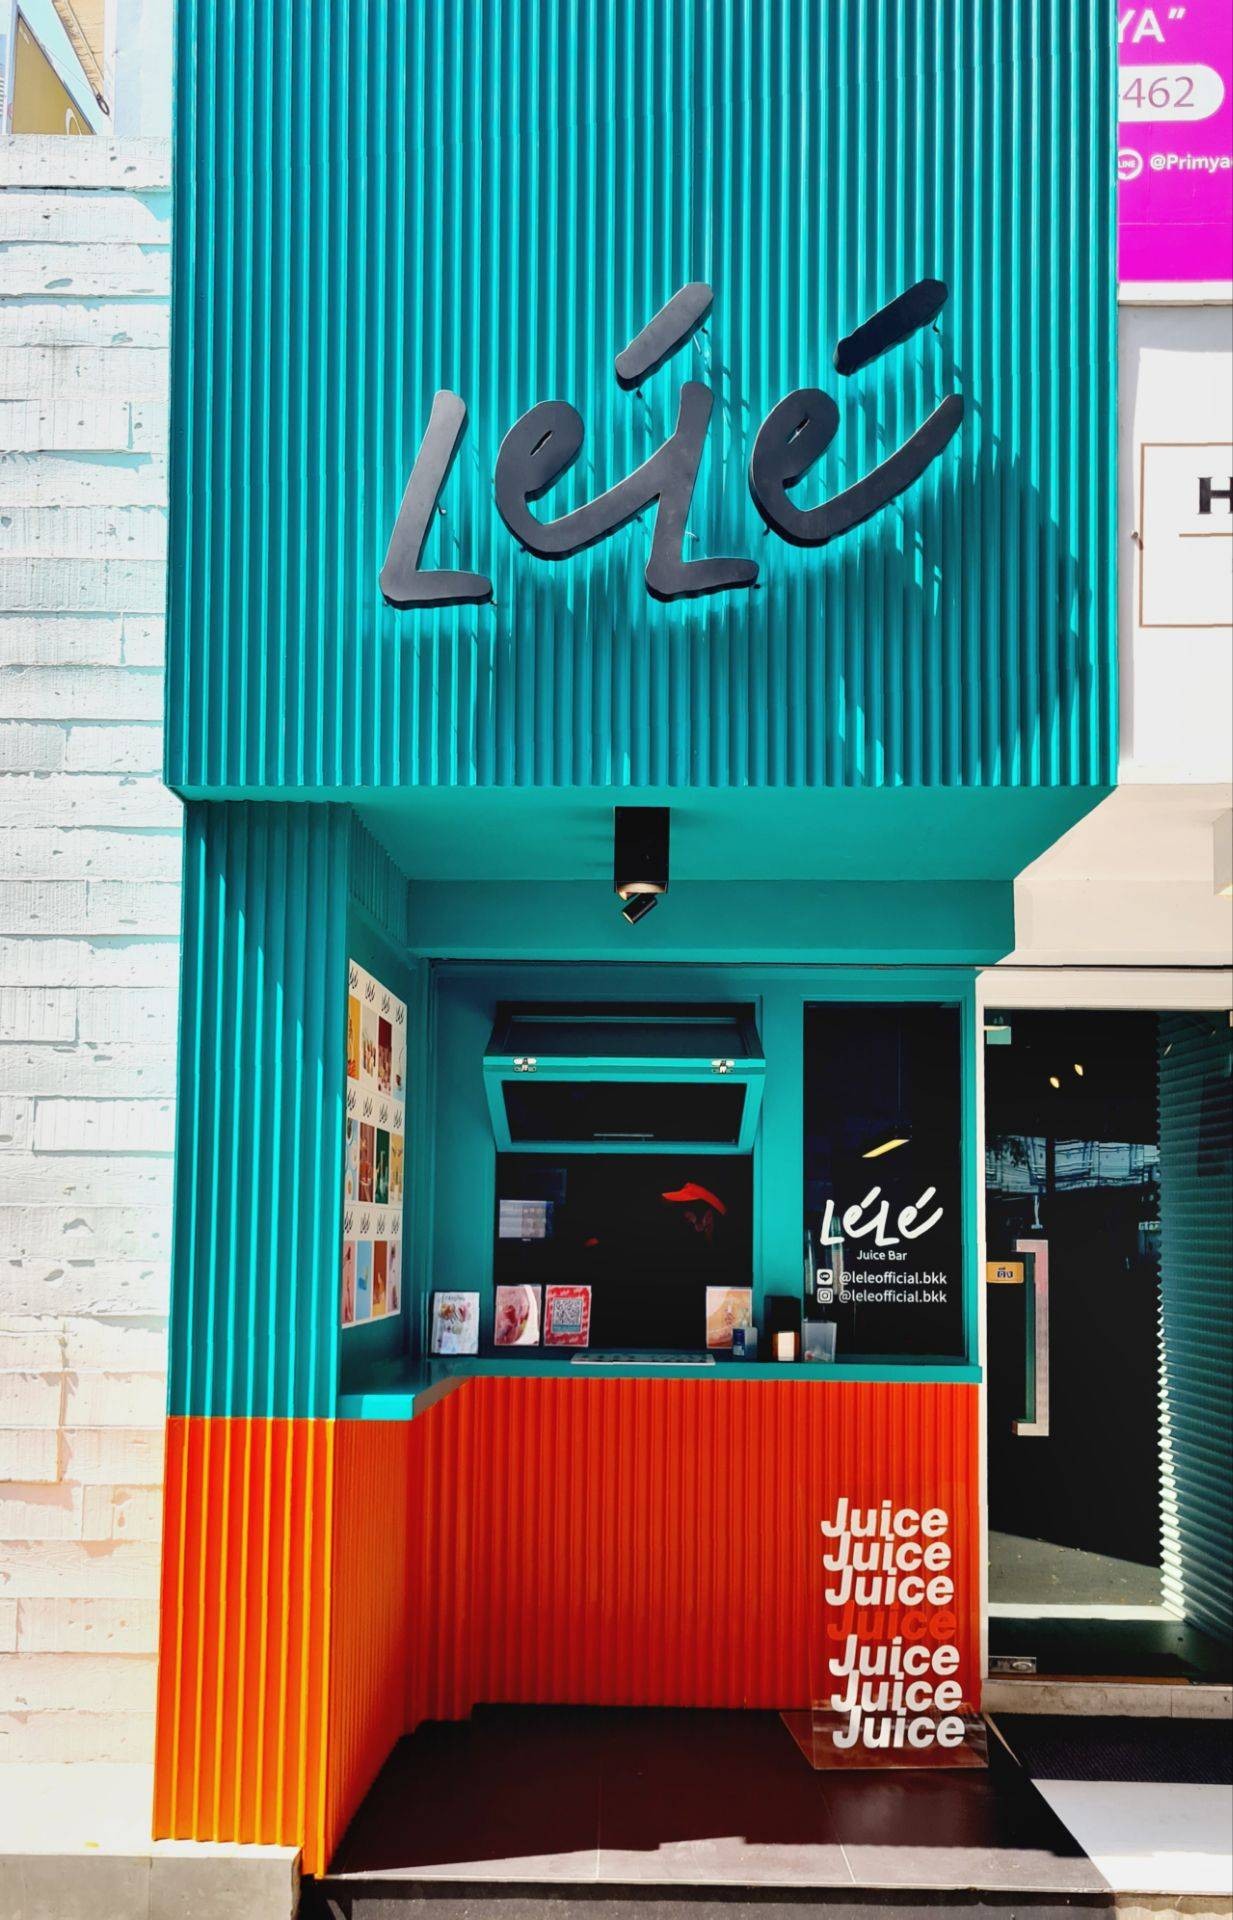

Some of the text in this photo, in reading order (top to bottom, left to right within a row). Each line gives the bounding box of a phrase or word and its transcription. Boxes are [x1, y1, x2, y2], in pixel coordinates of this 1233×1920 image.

[1118, 76, 1195, 108] 462
[1150, 154, 1233, 173] @Primya
[856, 1250, 908, 1261] Juice Bar
[839, 1271, 948, 1285] @leleofficial.bkk
[839, 1290, 948, 1303] @leleofficial.bkk
[820, 1497, 949, 1538] Juice
[823, 1531, 952, 1572] Juice
[825, 1565, 955, 1606] Juice
[827, 1601, 958, 1641] Juice
[829, 1634, 961, 1676] Juice
[831, 1669, 964, 1712] Juice
[832, 1705, 966, 1749] Juice
